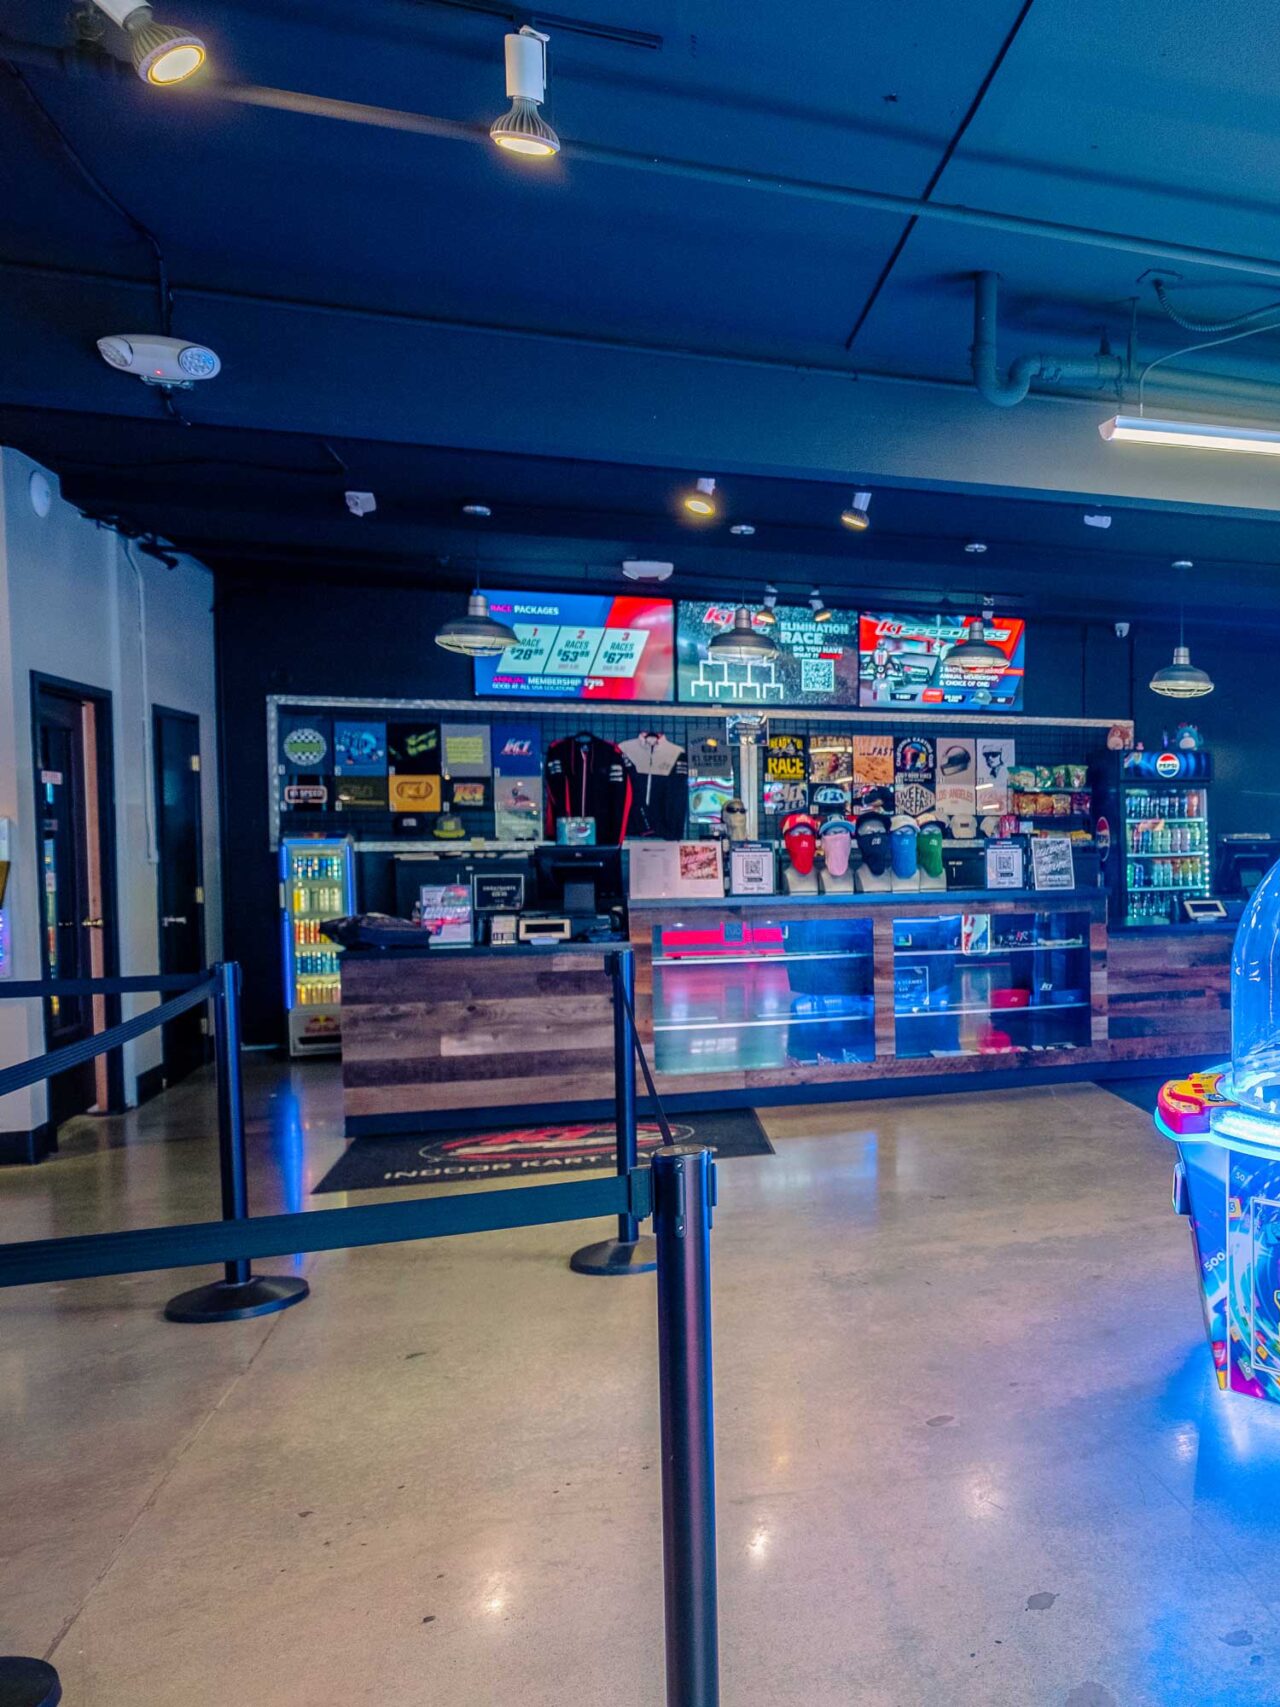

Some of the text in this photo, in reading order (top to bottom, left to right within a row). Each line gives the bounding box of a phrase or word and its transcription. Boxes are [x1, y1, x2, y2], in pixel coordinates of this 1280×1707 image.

[514, 605, 559, 615] PACKAGES
[780, 622, 849, 634] ELIMINATION
[576, 630, 585, 639] 2
[622, 632, 631, 641] 3
[780, 632, 824, 645] RACE
[564, 640, 590, 650] RACES
[610, 642, 635, 651] RACES
[527, 676, 582, 686] MEMBERSHIP
[872, 747, 893, 756] FAST
[768, 757, 805, 774] RACE
[384, 1162, 511, 1180] INDOOR
[521, 1155, 599, 1168] KART
[1203, 1251, 1225, 1271] 500
